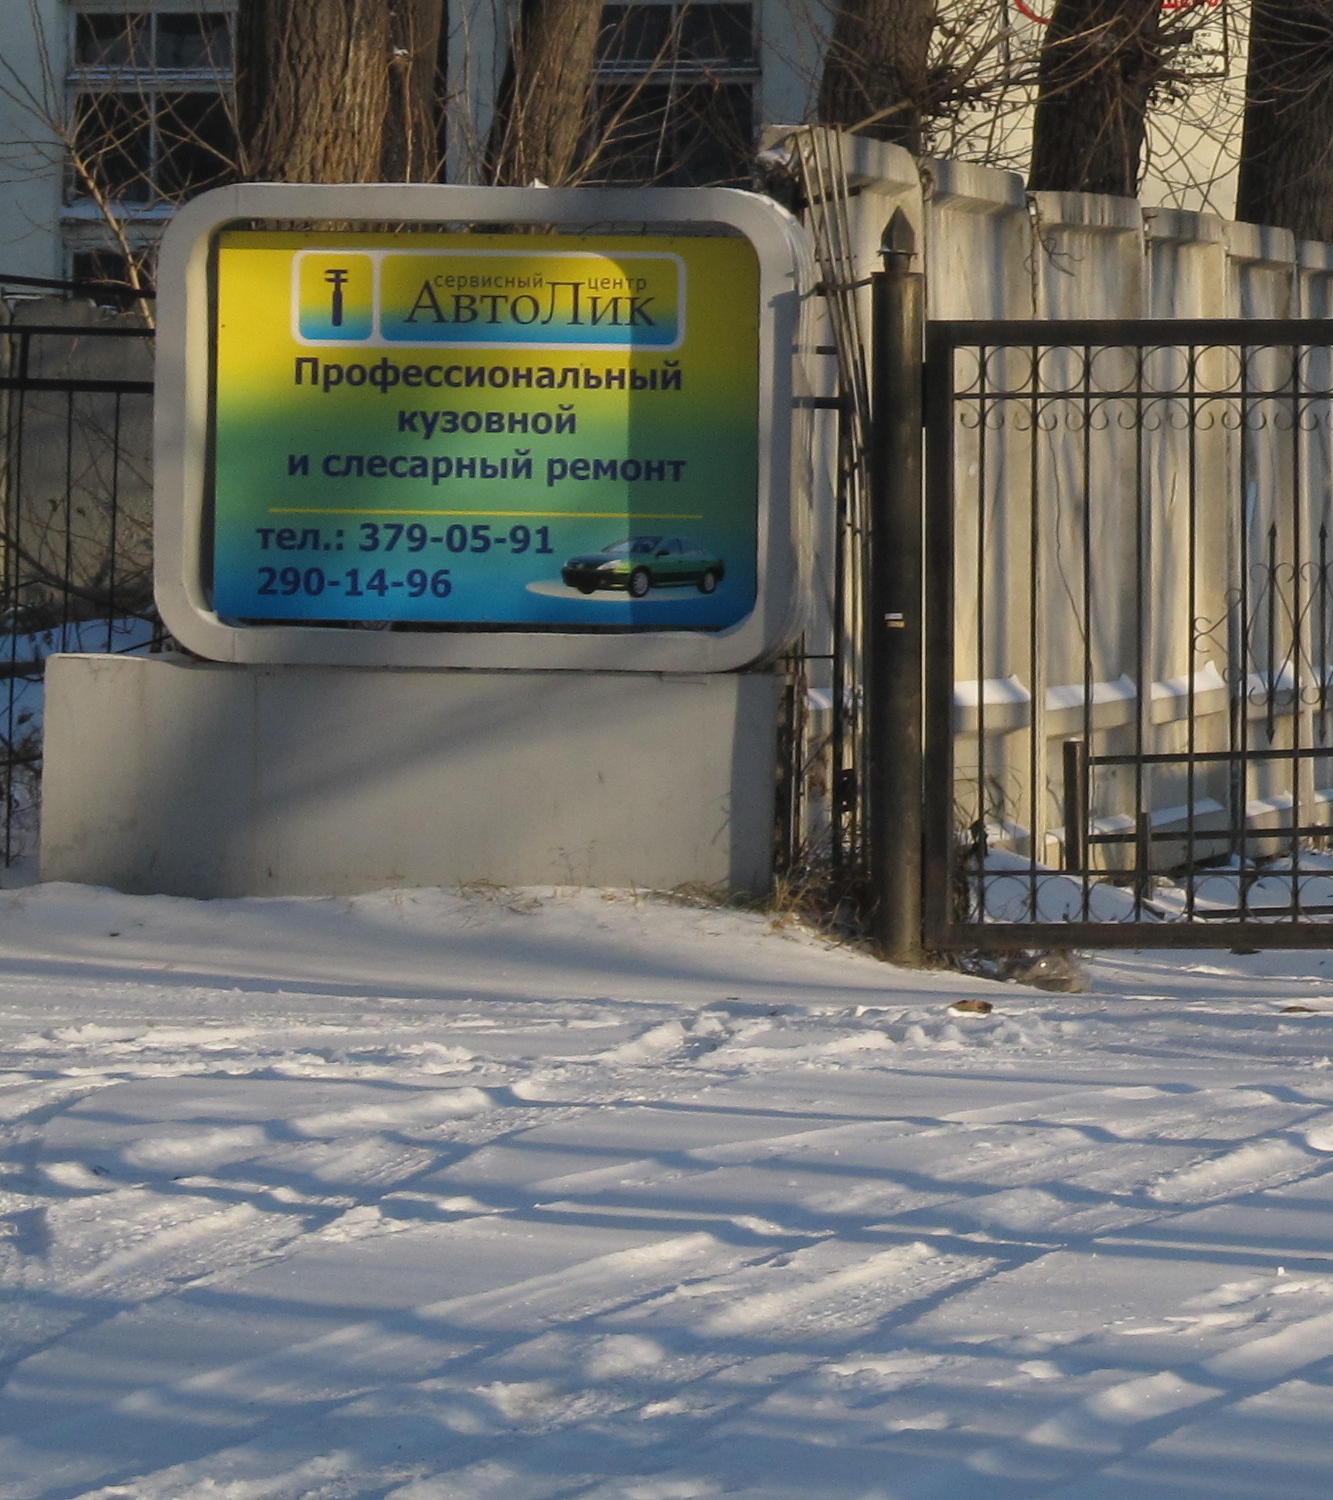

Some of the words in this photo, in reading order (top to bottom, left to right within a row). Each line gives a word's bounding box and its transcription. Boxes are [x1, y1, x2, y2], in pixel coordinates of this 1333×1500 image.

[434, 273, 544, 290] сервисный
[587, 275, 648, 294] центр
[294, 357, 682, 393] Профессиональный
[397, 404, 577, 439] кузовной
[287, 454, 309, 476] и
[322, 449, 532, 485] слесарный
[546, 456, 686, 487] ремонт
[256, 528, 344, 552] тел.:
[358, 523, 554, 555] 379-05-91
[257, 566, 452, 598] 290-14-96
